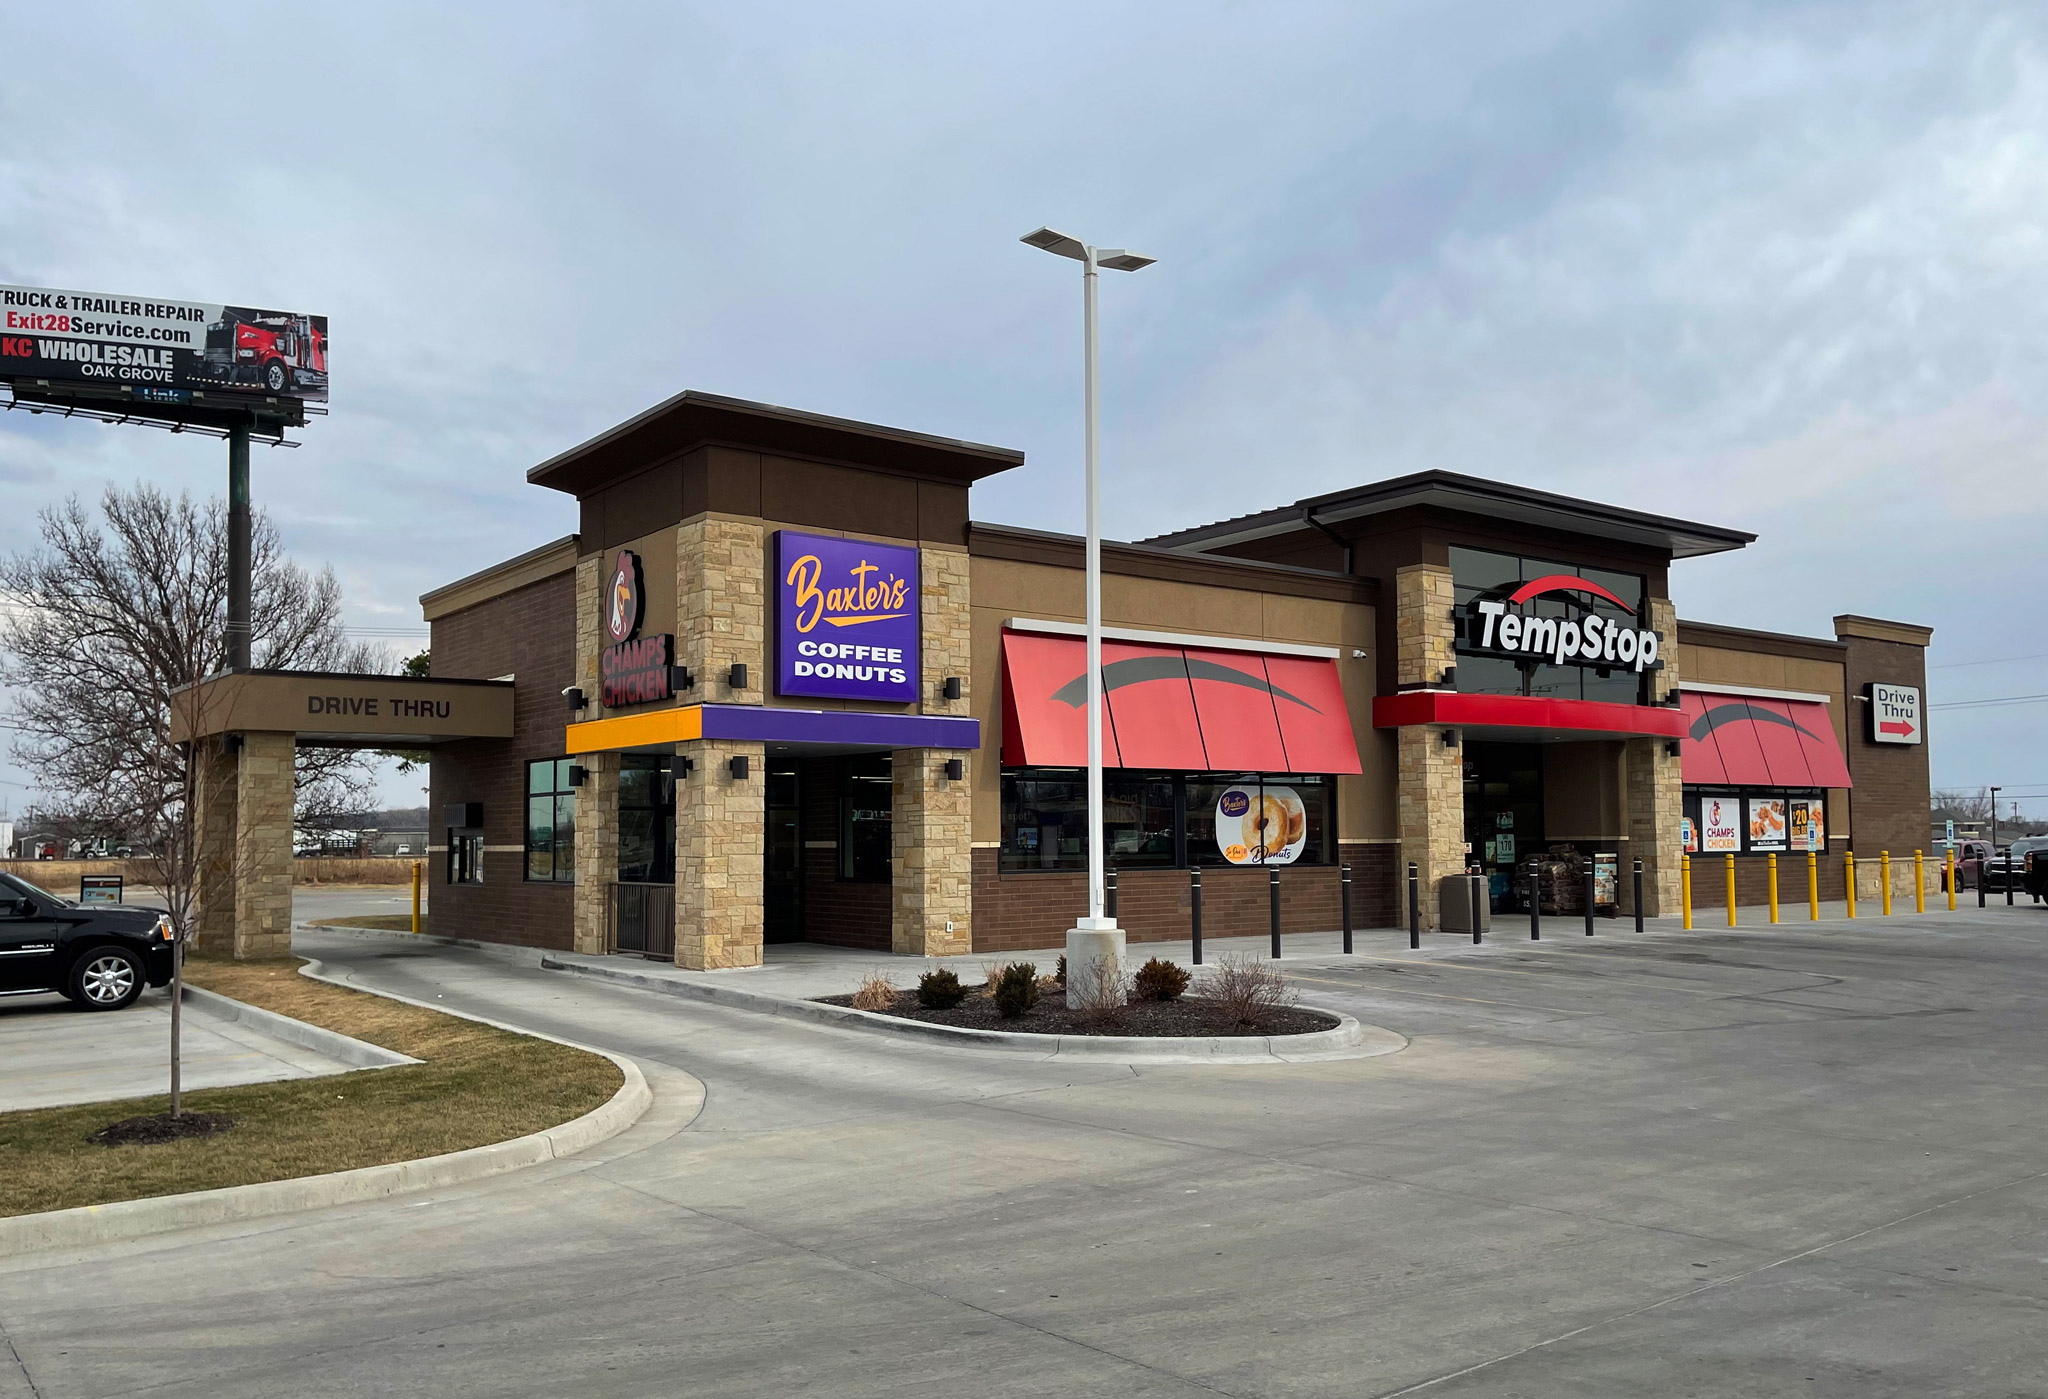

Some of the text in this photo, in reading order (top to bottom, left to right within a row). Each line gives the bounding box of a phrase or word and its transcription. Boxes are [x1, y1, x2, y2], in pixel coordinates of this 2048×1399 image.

[55, 294, 68, 310] &
[71, 296, 141, 316] TRAILER
[144, 304, 205, 322] REPAIR
[7, 311, 191, 343] Exit28Service.com
[2, 337, 174, 369] KC WHOLESALE
[81, 364, 174, 383] OAK GROVE
[787, 555, 910, 633] Baxter's
[1478, 601, 1658, 672] TempStop
[603, 634, 666, 676] CHAMPS
[797, 640, 903, 664] COFFEE
[794, 661, 907, 684] DONUTS
[602, 665, 668, 708] CHICKEN
[1878, 688, 1915, 704] Drive
[308, 696, 450, 719] DRIVE THRU
[1881, 703, 1914, 719] Thru
[1707, 828, 1735, 838] CHAMPS
[1707, 839, 1736, 849] CHICKEN
[1250, 845, 1292, 863] Donuts
